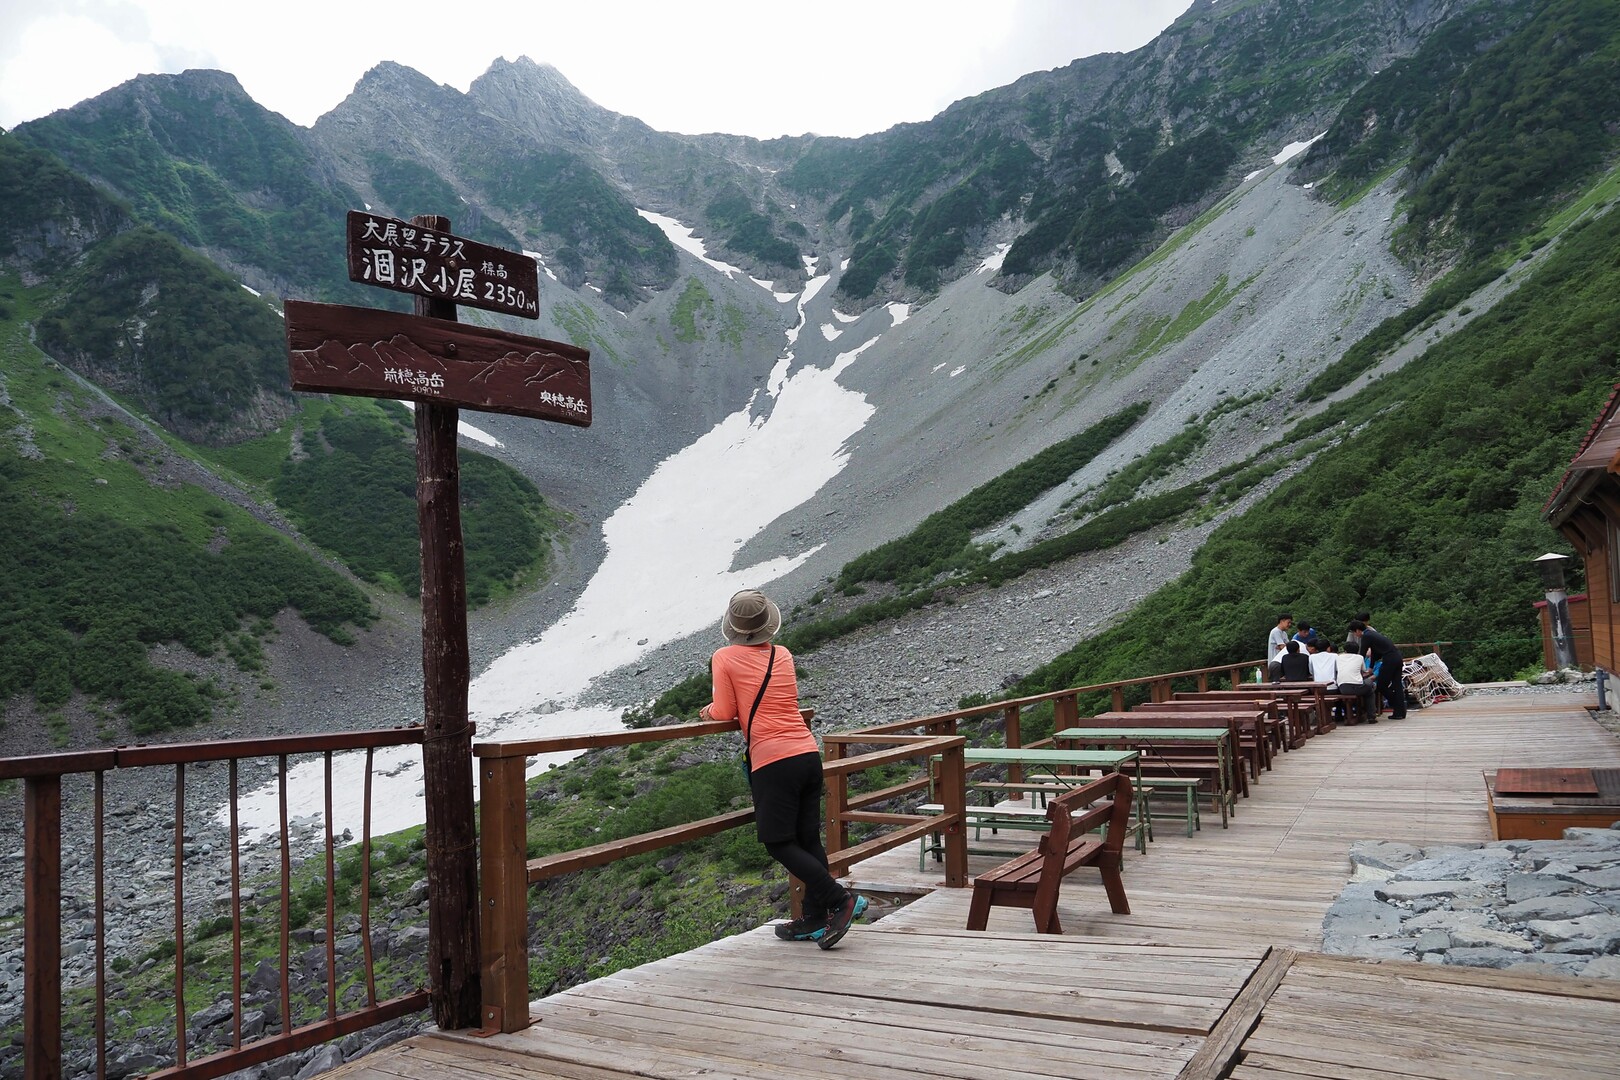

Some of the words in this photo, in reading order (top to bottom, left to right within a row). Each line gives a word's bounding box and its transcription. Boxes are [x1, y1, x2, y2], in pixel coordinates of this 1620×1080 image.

[361, 216, 467, 261] 大展望テラス
[362, 247, 478, 300] 涸沢小屋
[480, 260, 508, 280] 標高
